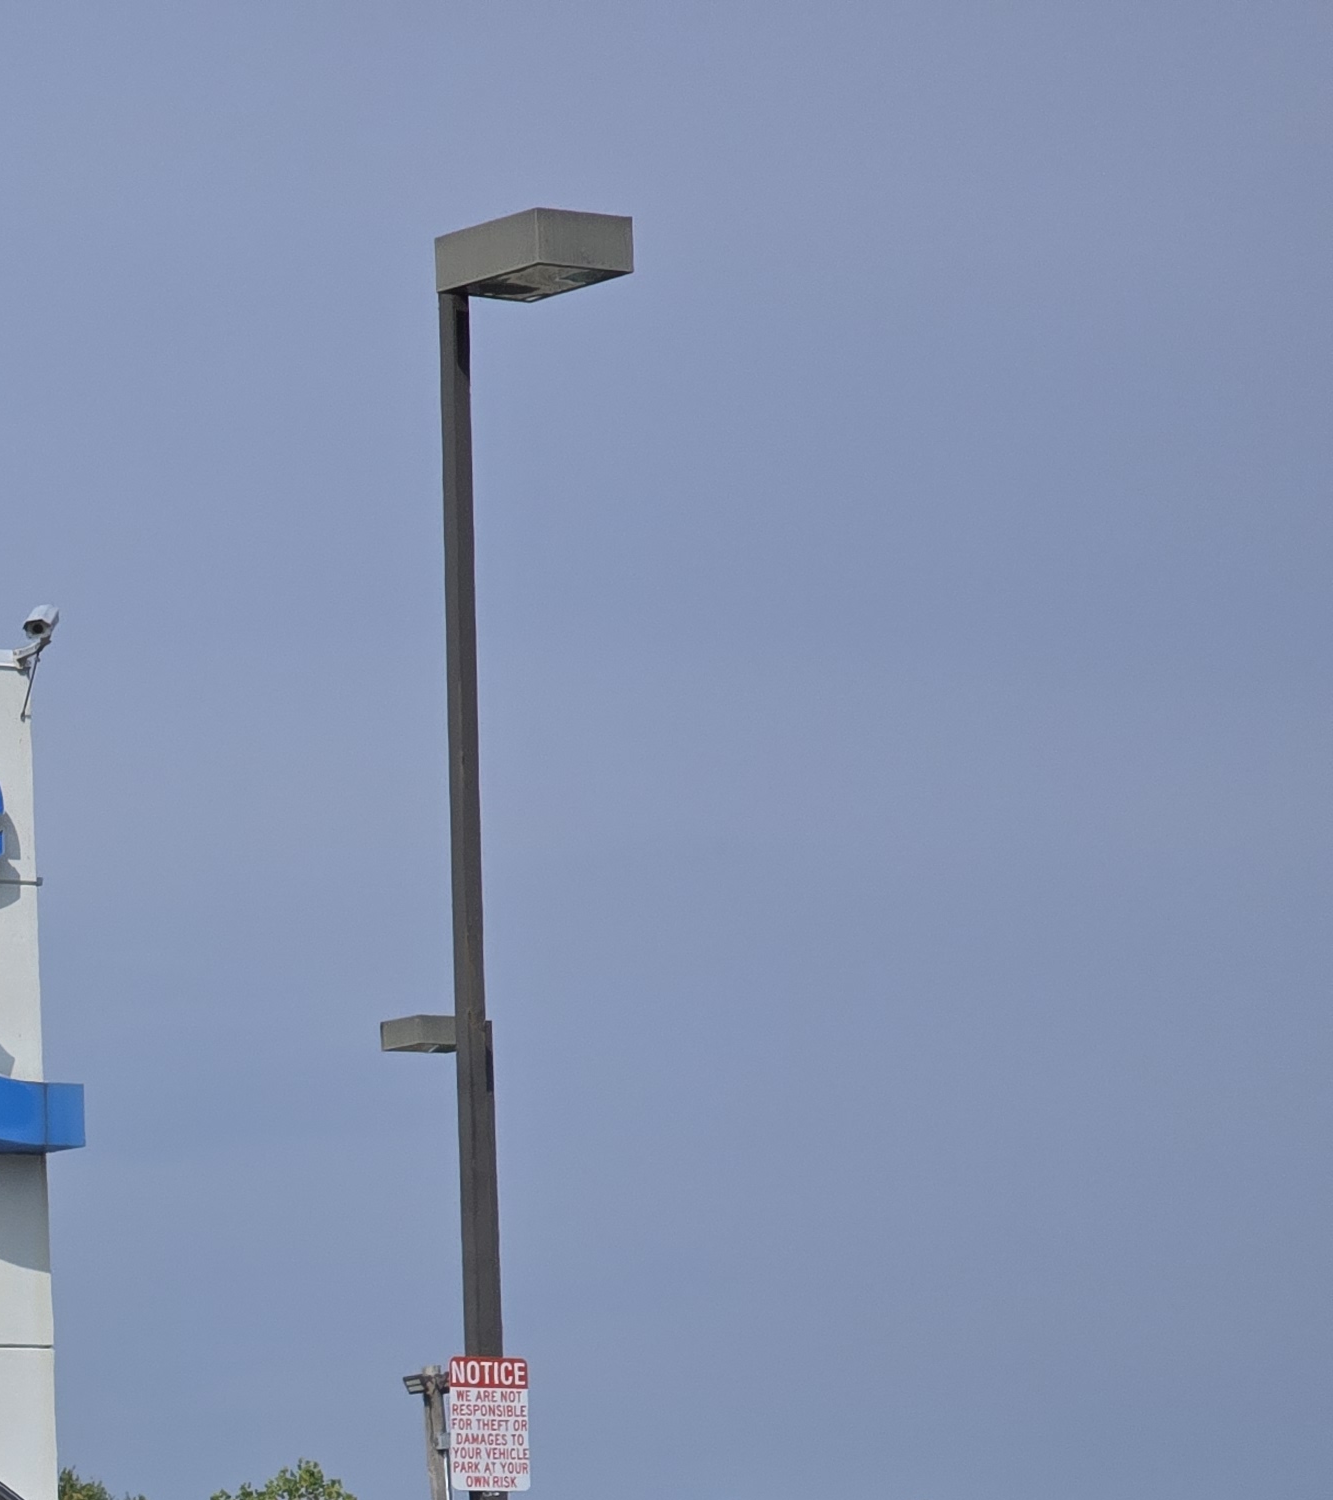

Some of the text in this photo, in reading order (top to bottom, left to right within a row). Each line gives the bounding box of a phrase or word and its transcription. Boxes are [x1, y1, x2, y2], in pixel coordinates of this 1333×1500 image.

[451, 1361, 526, 1385] NOTICE
[456, 1390, 522, 1403] WE ARE NOT
[452, 1404, 527, 1417] RESPONSIBLE
[451, 1418, 527, 1432] FOR THEFT OR
[455, 1433, 525, 1446] DAMAGES TO
[452, 1447, 529, 1460] YOUR VEHICLE
[453, 1461, 529, 1475] PARK AT YOUR
[465, 1475, 518, 1488] OWN RISK
